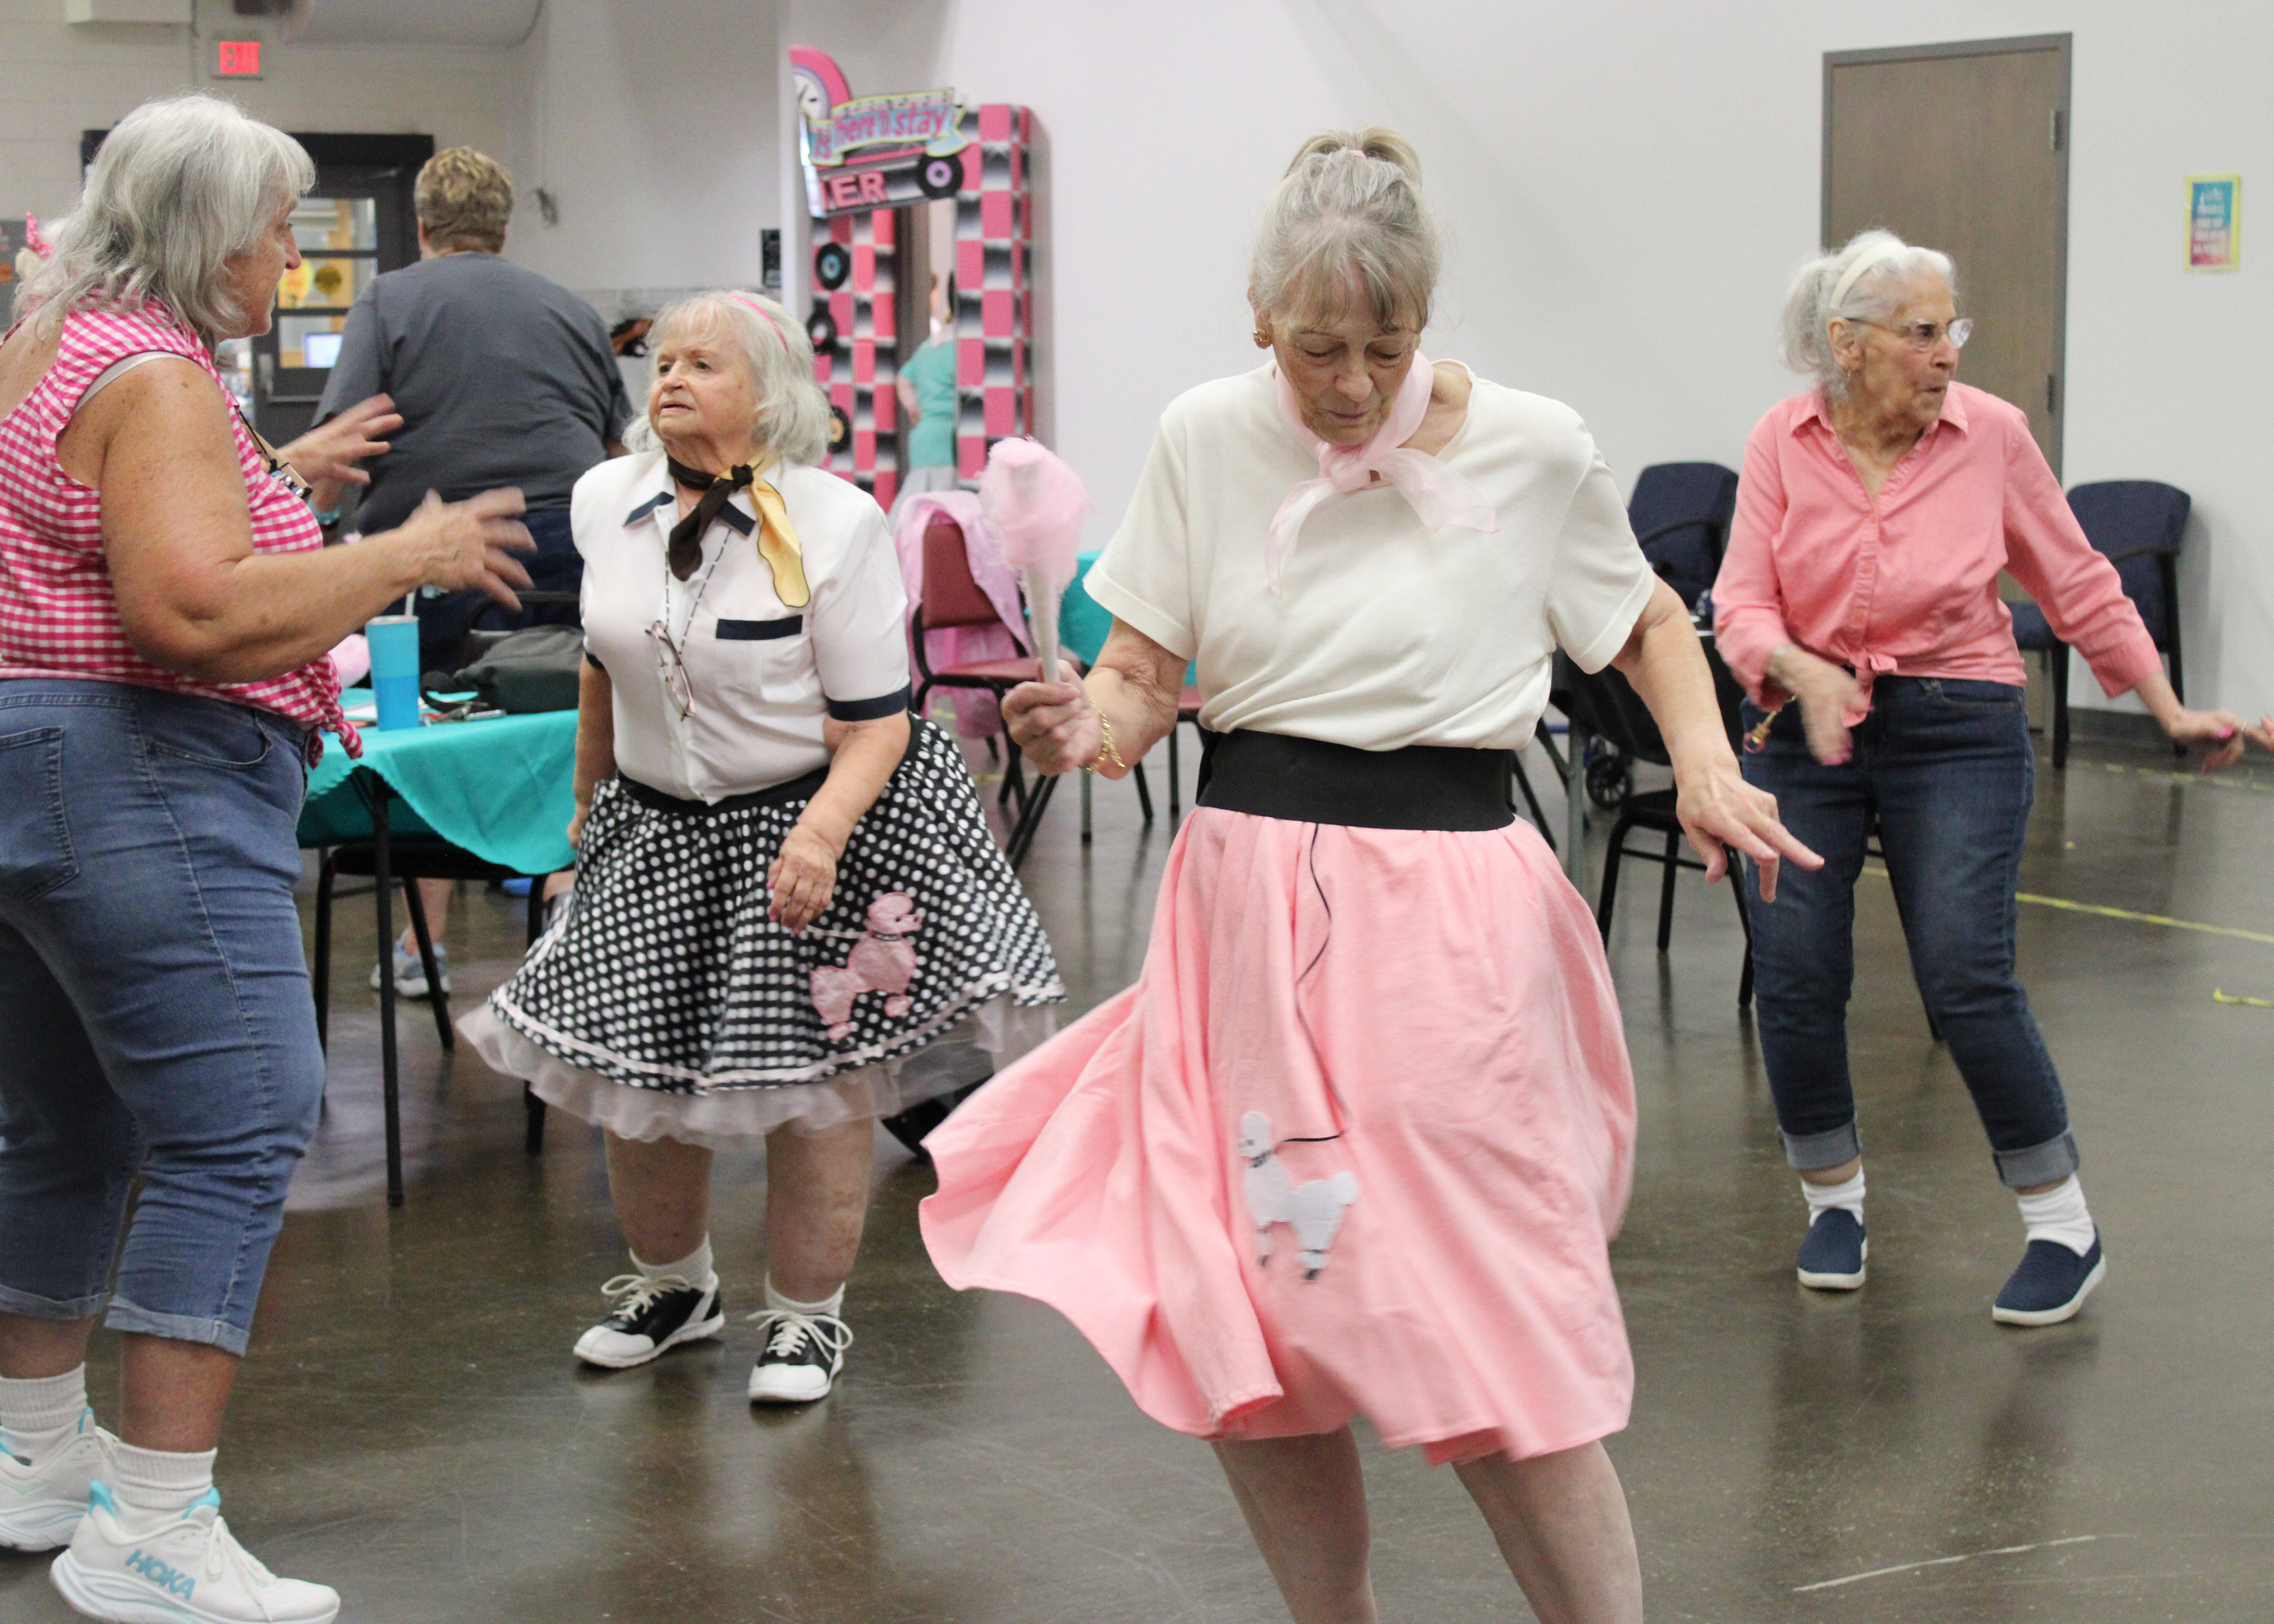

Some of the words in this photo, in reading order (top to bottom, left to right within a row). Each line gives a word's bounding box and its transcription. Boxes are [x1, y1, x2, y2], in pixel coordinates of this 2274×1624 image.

[220, 41, 260, 74] EXIT
[894, 103, 948, 138] stay
[125, 1549, 196, 1600] HOKA
